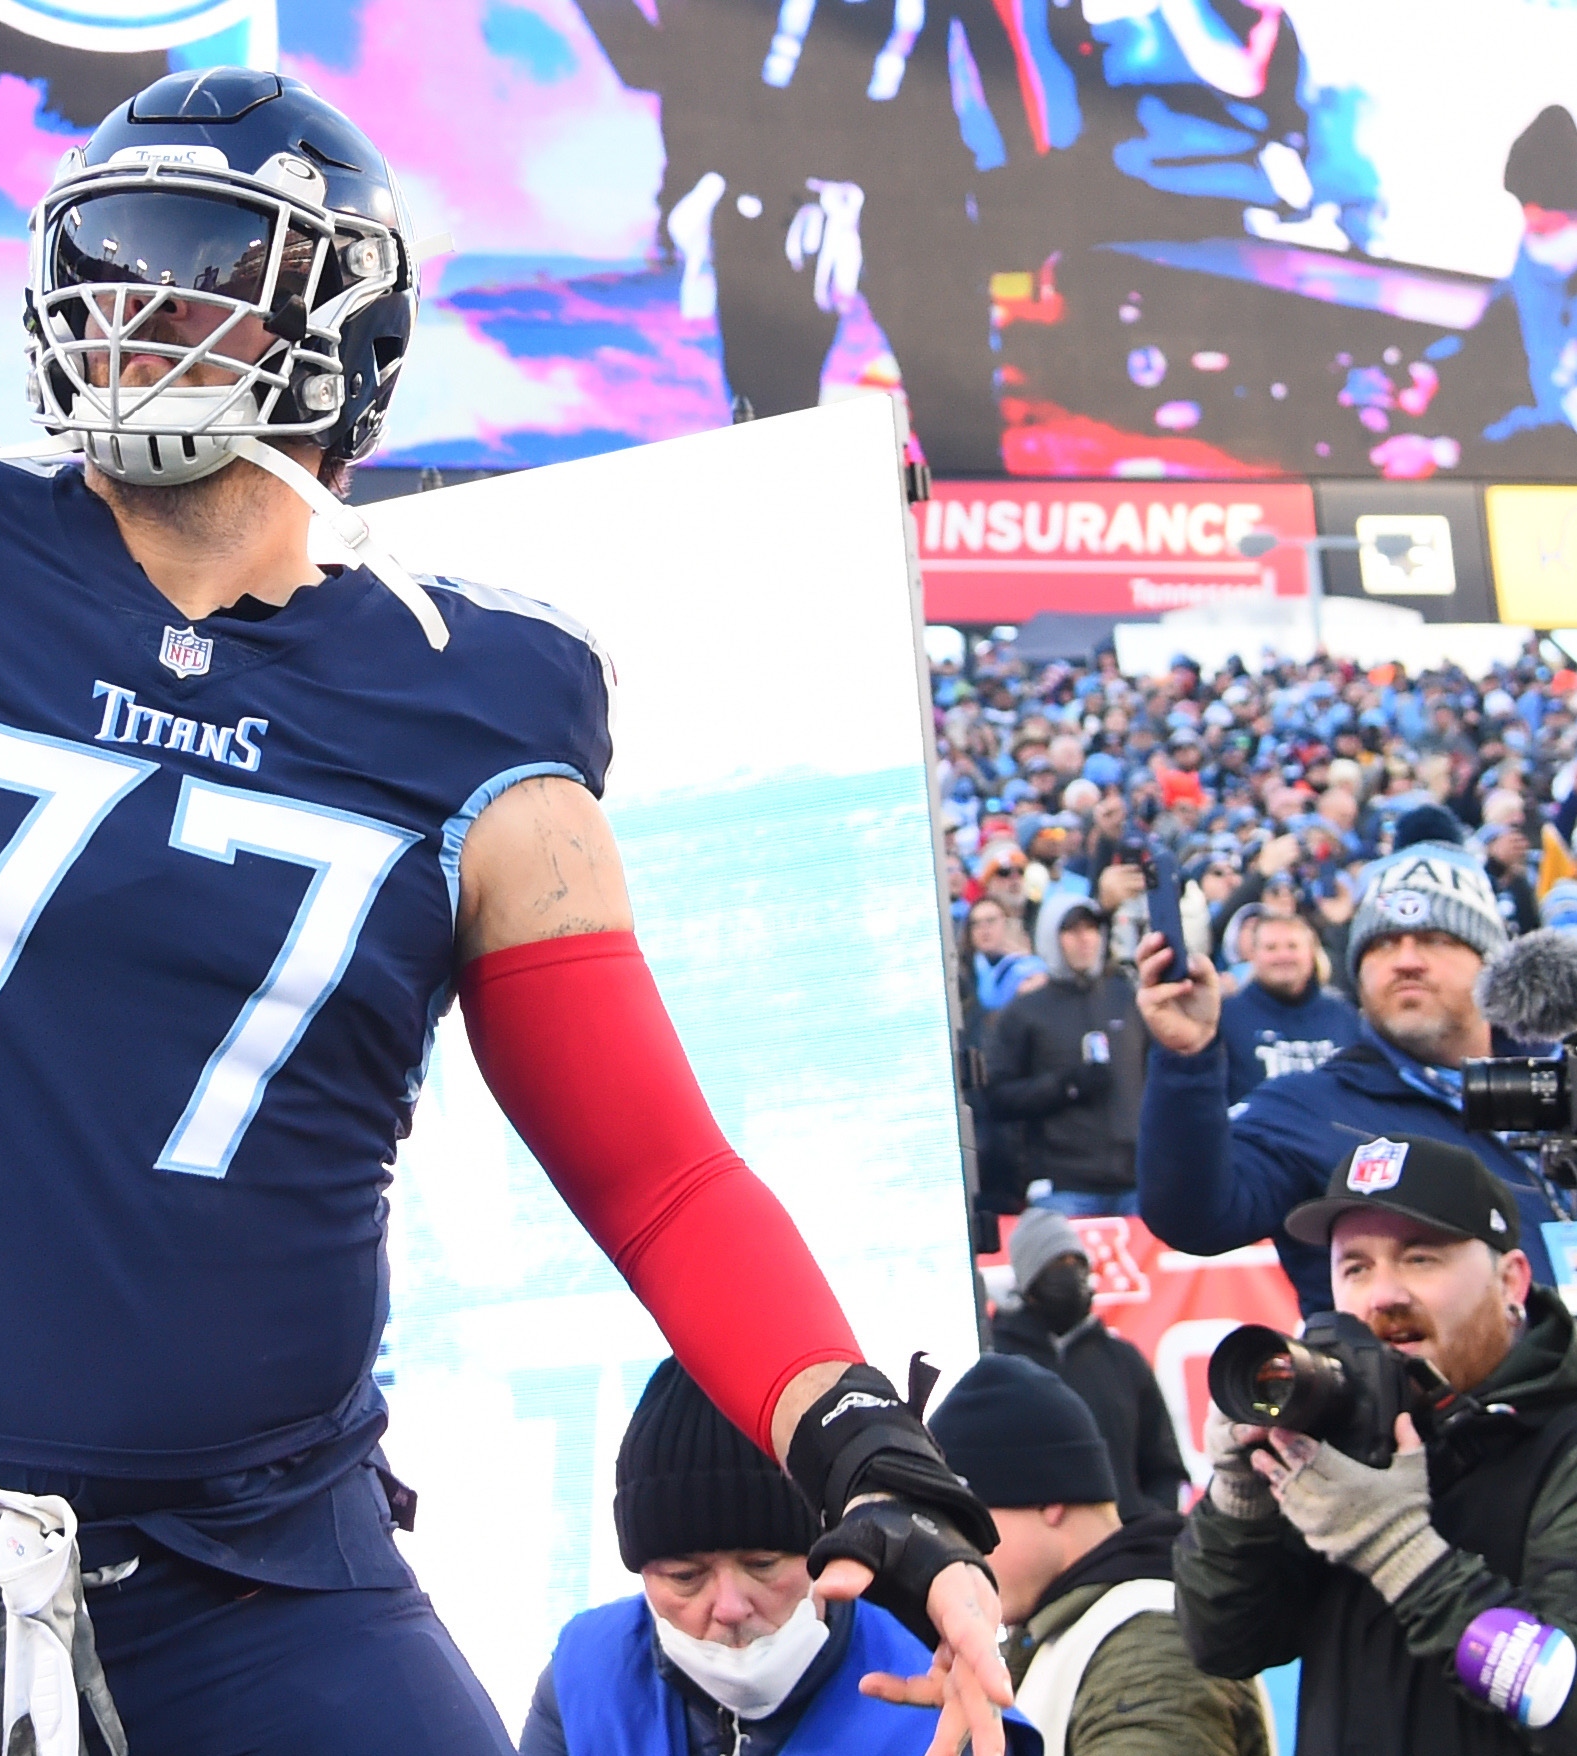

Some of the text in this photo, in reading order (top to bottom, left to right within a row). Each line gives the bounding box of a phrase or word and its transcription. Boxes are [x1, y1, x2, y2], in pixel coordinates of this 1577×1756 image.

[924, 500, 1263, 554] INSURANCE
[169, 644, 202, 667] NFL
[91, 679, 269, 773] TITANS
